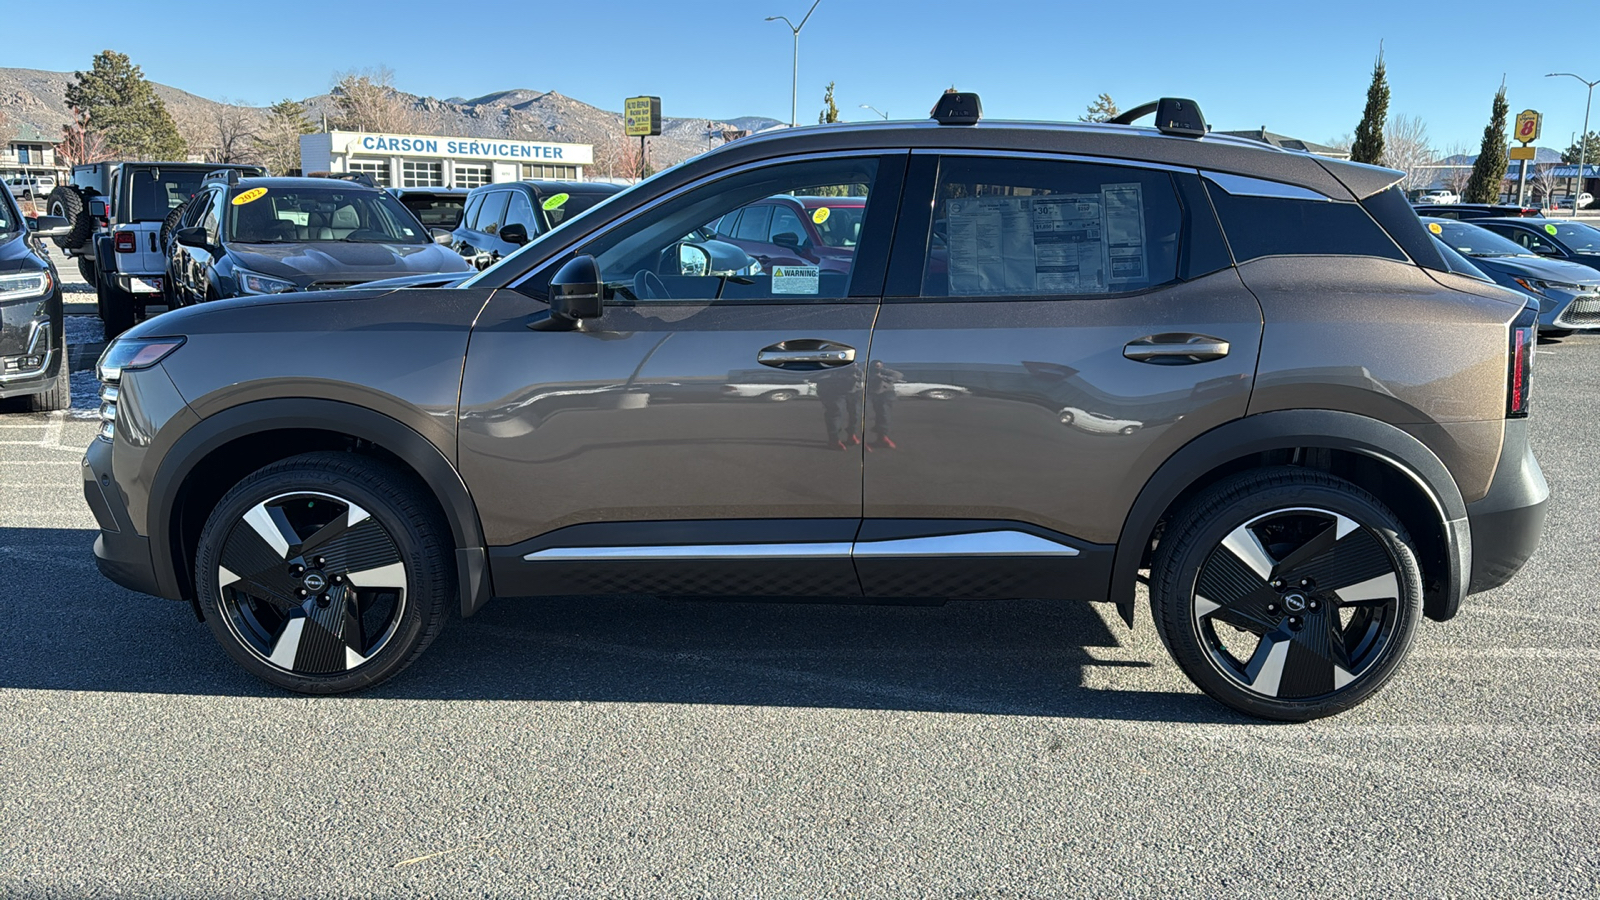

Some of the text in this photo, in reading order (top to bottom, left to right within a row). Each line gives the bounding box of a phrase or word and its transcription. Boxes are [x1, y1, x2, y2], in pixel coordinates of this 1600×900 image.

[1520, 120, 1535, 136] 8
[363, 136, 563, 159] CARSON SERVICENTER
[238, 189, 262, 202] 2022
[1037, 206, 1049, 215] 30
[1396, 541, 1419, 613] BRIDGESTONE
